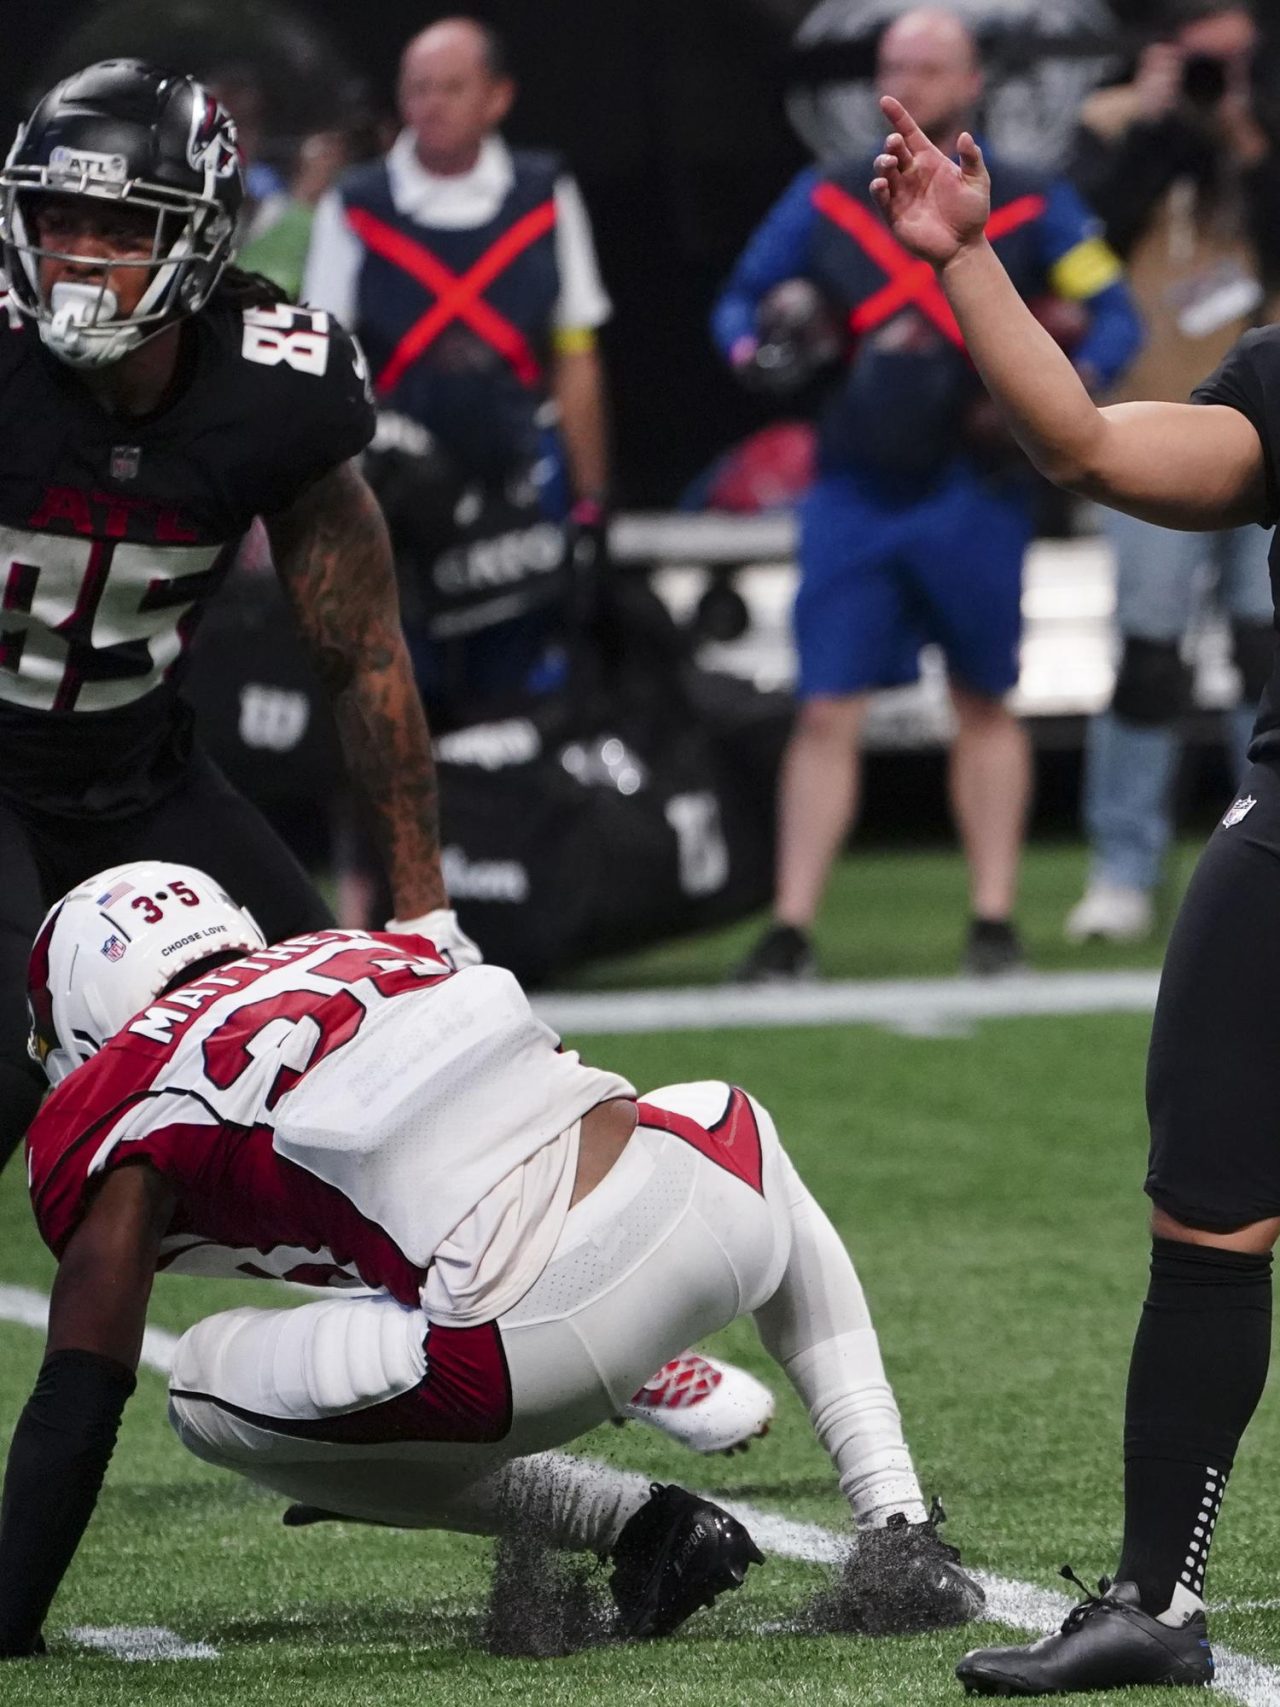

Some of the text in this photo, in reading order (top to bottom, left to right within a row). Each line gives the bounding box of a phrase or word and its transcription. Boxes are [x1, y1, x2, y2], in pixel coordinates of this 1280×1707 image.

[28, 486, 199, 542] ATL
[161, 925, 228, 957] CHOOSE LOVE
